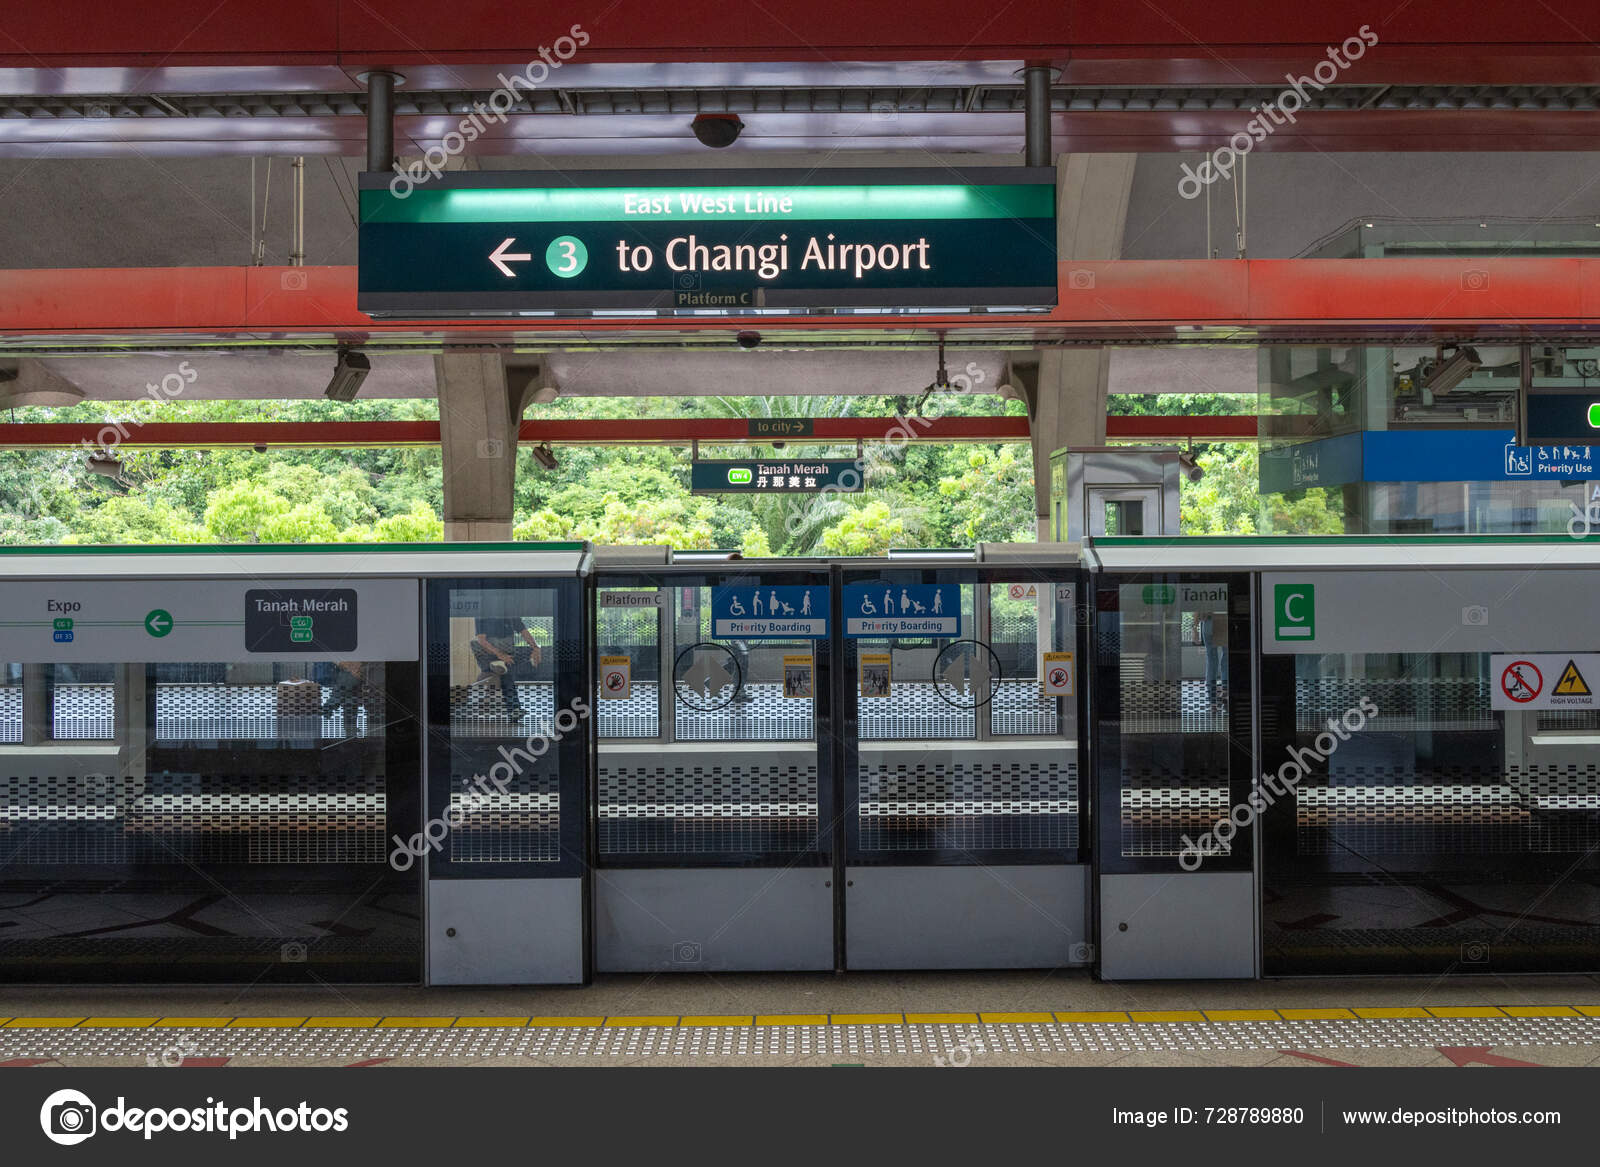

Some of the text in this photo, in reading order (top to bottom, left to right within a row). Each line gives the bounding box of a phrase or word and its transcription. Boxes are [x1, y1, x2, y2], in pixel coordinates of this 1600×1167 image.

[624, 192, 793, 214] East West Line
[558, 233, 930, 279] 3 to Changi Airport
[679, 292, 749, 305] Platform C
[757, 421, 791, 434] to city
[757, 463, 829, 475] Tanah Merah
[1576, 463, 1593, 473] Use
[606, 594, 662, 605] Platform C
[1058, 589, 1071, 600] 12
[1183, 587, 1228, 601] Tanah
[48, 599, 81, 614] Expo
[256, 598, 348, 611] Tanah Merah
[1284, 593, 1305, 622] C
[769, 622, 811, 634] Boarding
[900, 621, 942, 633] Boarding
